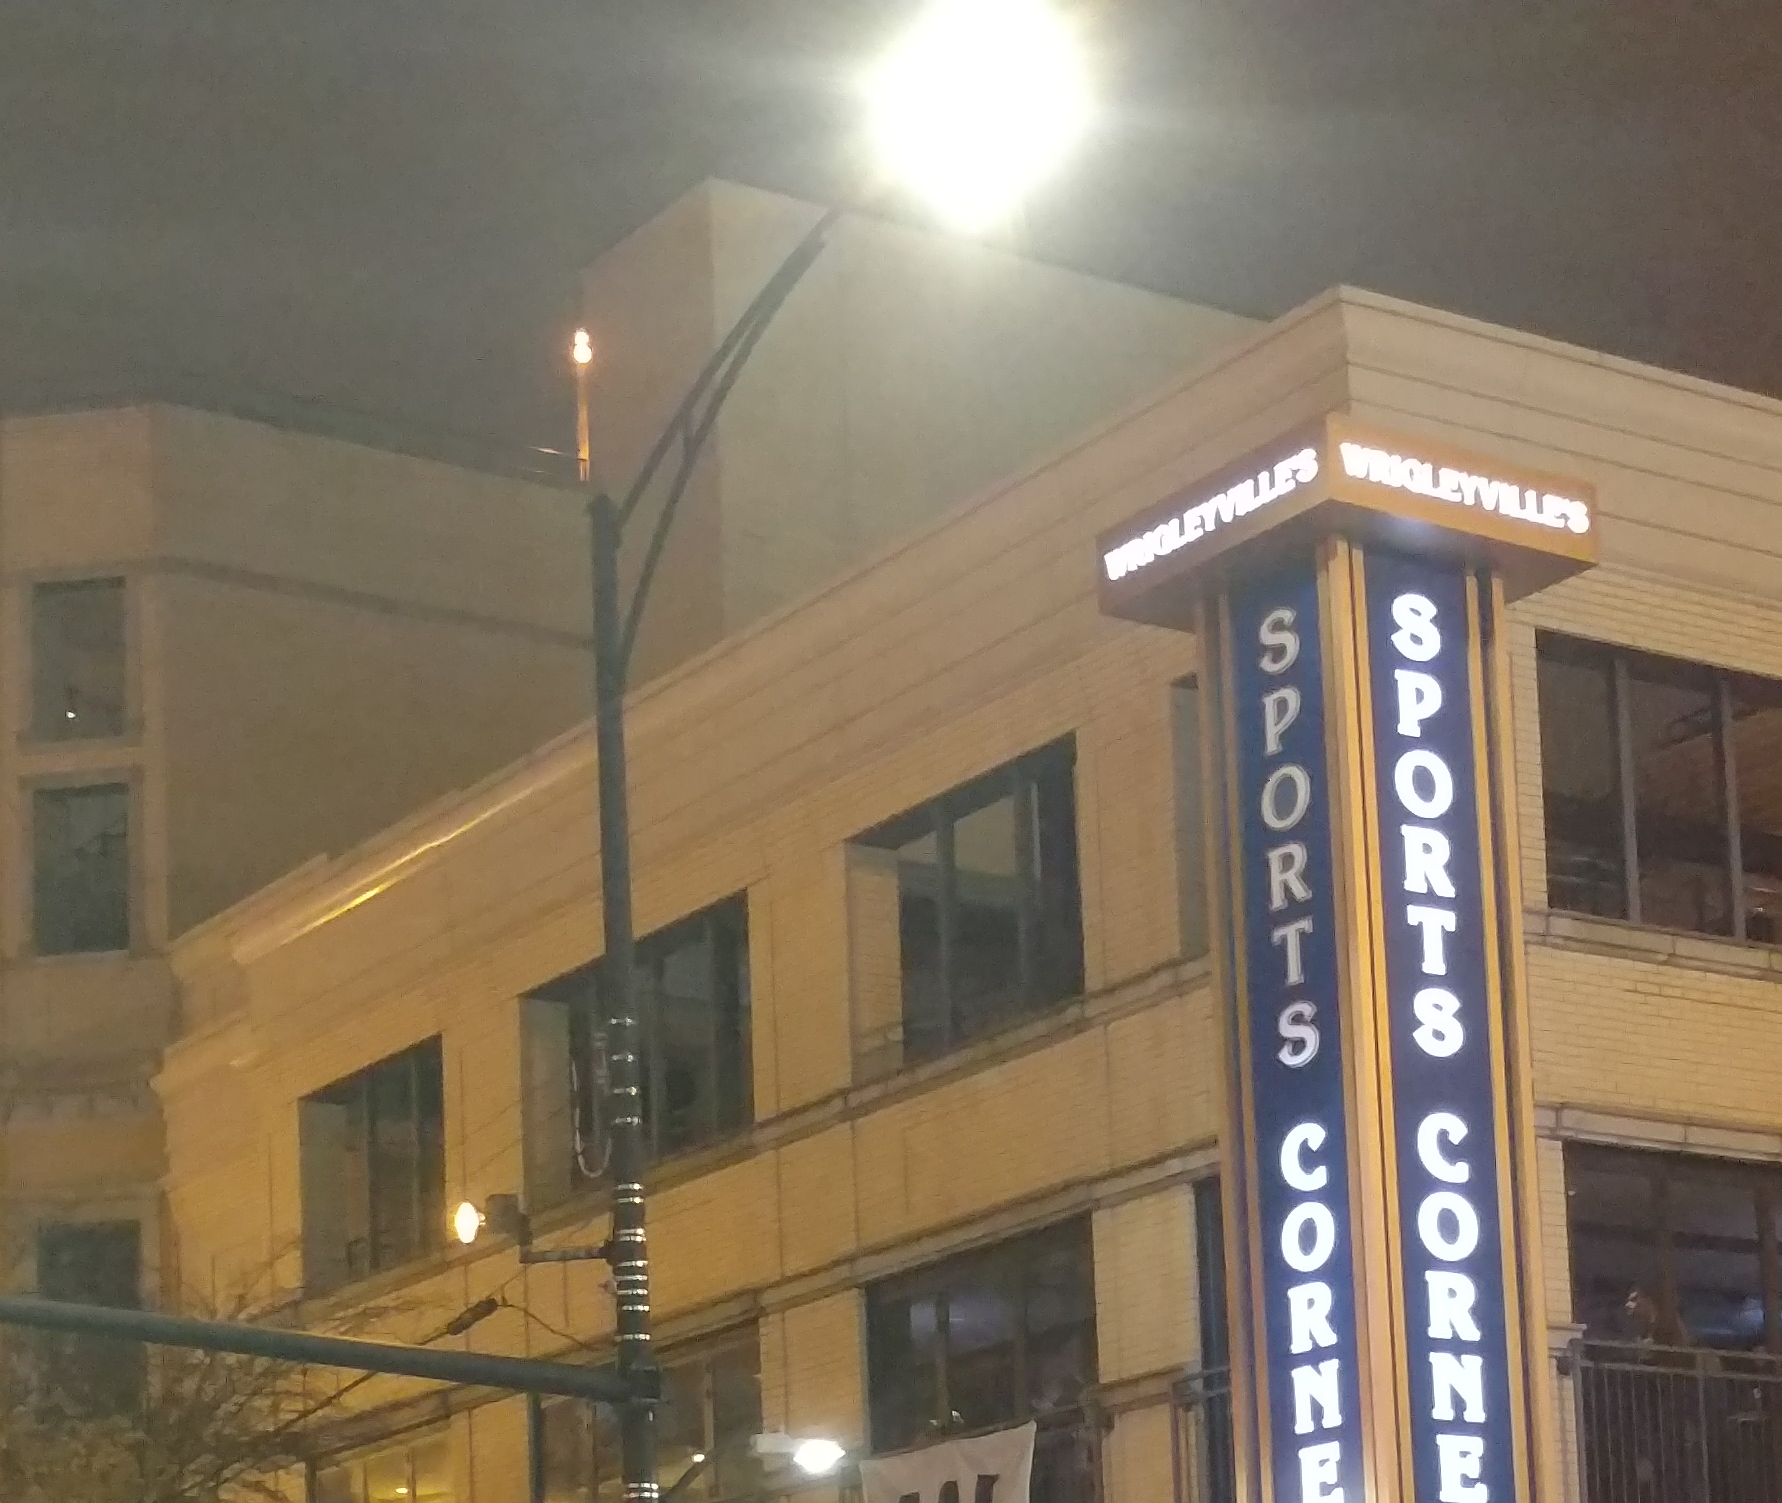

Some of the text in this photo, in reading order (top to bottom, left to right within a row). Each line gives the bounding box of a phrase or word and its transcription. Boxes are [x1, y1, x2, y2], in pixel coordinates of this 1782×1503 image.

[1104, 449, 1318, 580] WRIGLEYVILLE'S
[1340, 443, 1589, 533] WRIGLEYVILLE'S
[1259, 607, 1319, 1068] SPORTS
[1391, 593, 1465, 1058] SPORTS
